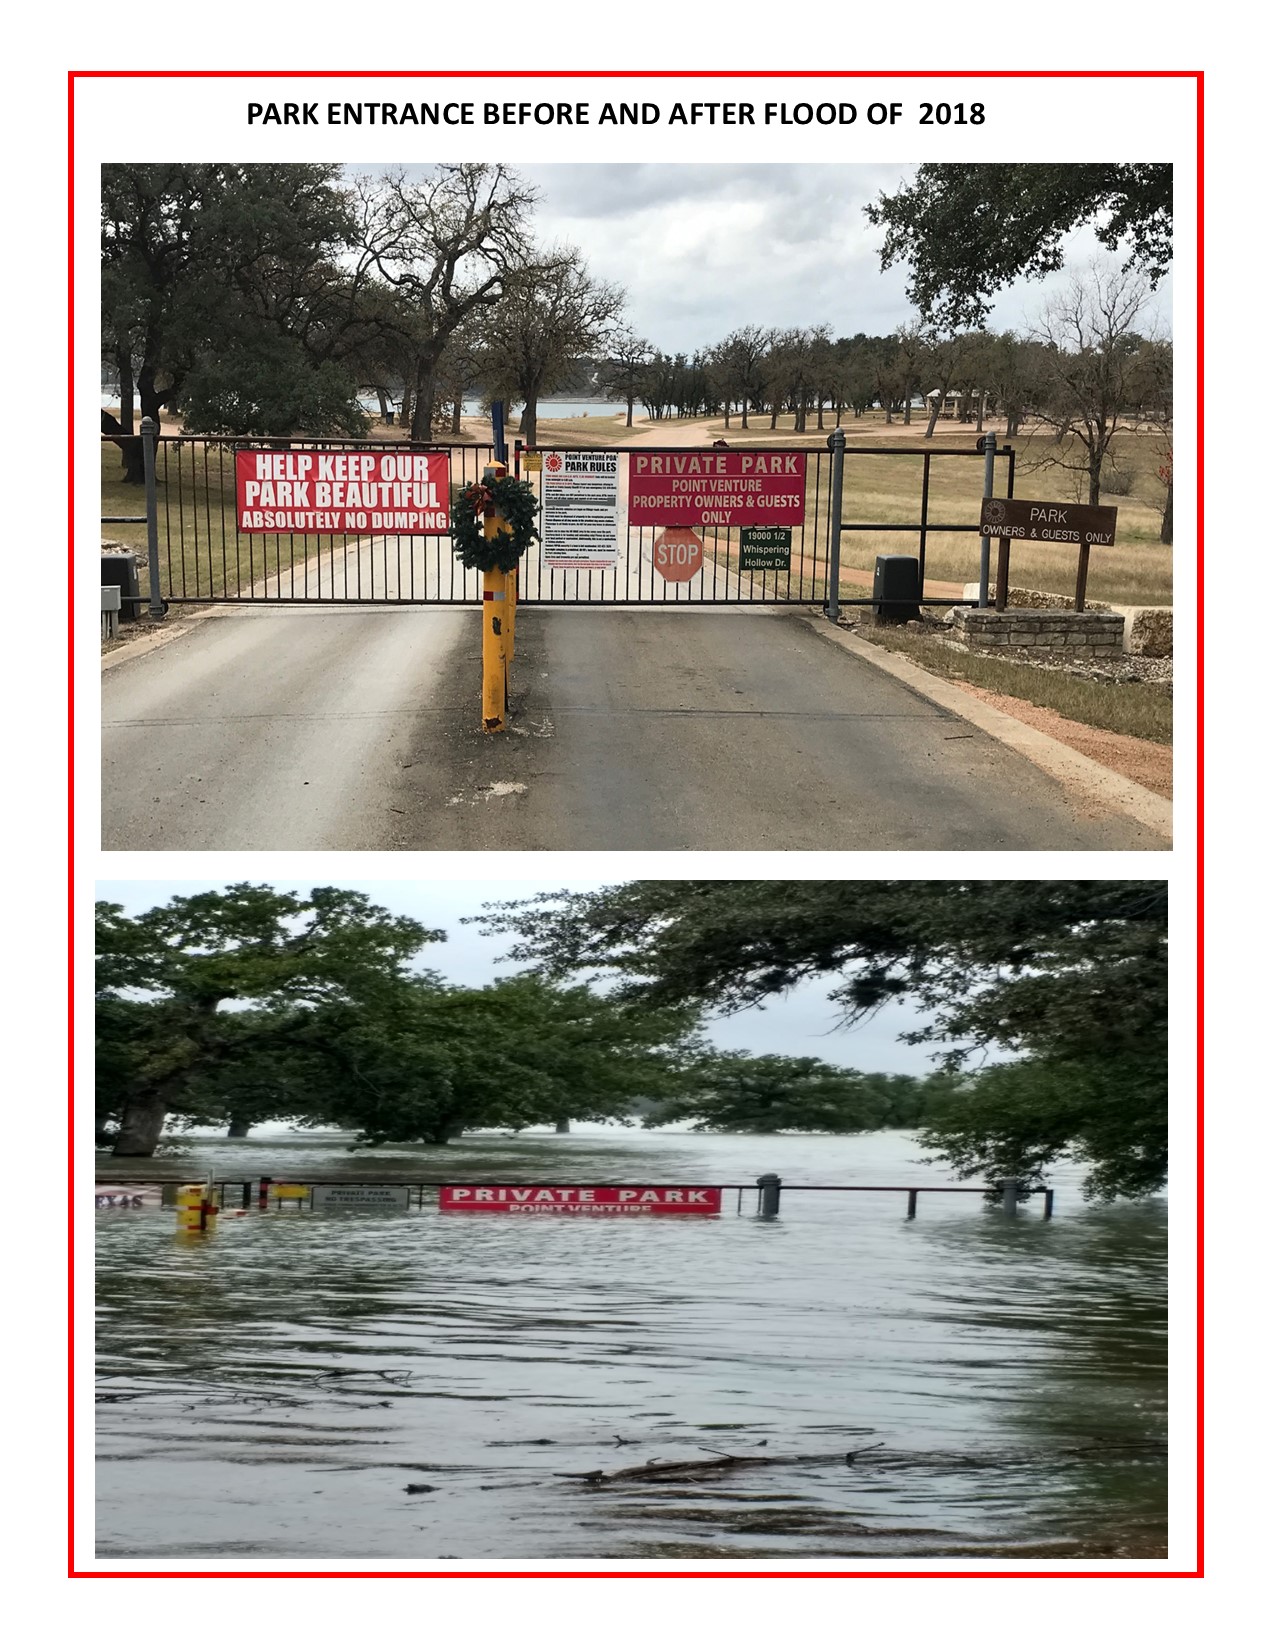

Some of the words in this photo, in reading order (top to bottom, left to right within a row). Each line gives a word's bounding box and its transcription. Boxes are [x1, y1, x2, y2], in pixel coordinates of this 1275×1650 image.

[256, 454, 313, 481] HELP
[318, 455, 376, 482] KEEP
[380, 455, 430, 482] OUR
[565, 461, 589, 472] PARK
[590, 462, 617, 472] RULES
[636, 456, 728, 474] PRIVATE
[741, 456, 798, 474] PARK
[672, 479, 707, 492] POINT
[710, 479, 762, 492] VENTURE
[245, 480, 311, 507] PARK
[315, 481, 441, 509] BEAUTIFUL
[633, 495, 693, 508] PROPERTY
[694, 495, 744, 508] OWNERS
[745, 495, 755, 508] &
[757, 494, 800, 508] GUESTS
[242, 510, 341, 529] ABSOLUTELY
[345, 511, 368, 529] NO
[371, 511, 447, 530] DUMPING
[701, 511, 732, 524] ONLY
[1029, 507, 1069, 524] PARK
[747, 532, 771, 541] 19000
[773, 531, 786, 541] 1/2
[982, 524, 1026, 538] OWNERS
[1030, 528, 1038, 538] &
[1041, 529, 1080, 542] GUESTS
[1085, 531, 1112, 544] ONLY
[657, 543, 699, 566] STOP
[743, 545, 790, 556] Whispering
[745, 558, 773, 567] Hollow
[775, 558, 787, 567] Dr.
[452, 1188, 596, 1202] PRIVATE
[619, 1190, 708, 1203] PARK
[509, 1204, 565, 1212] POINT
[568, 1204, 652, 1212] VENTURE
